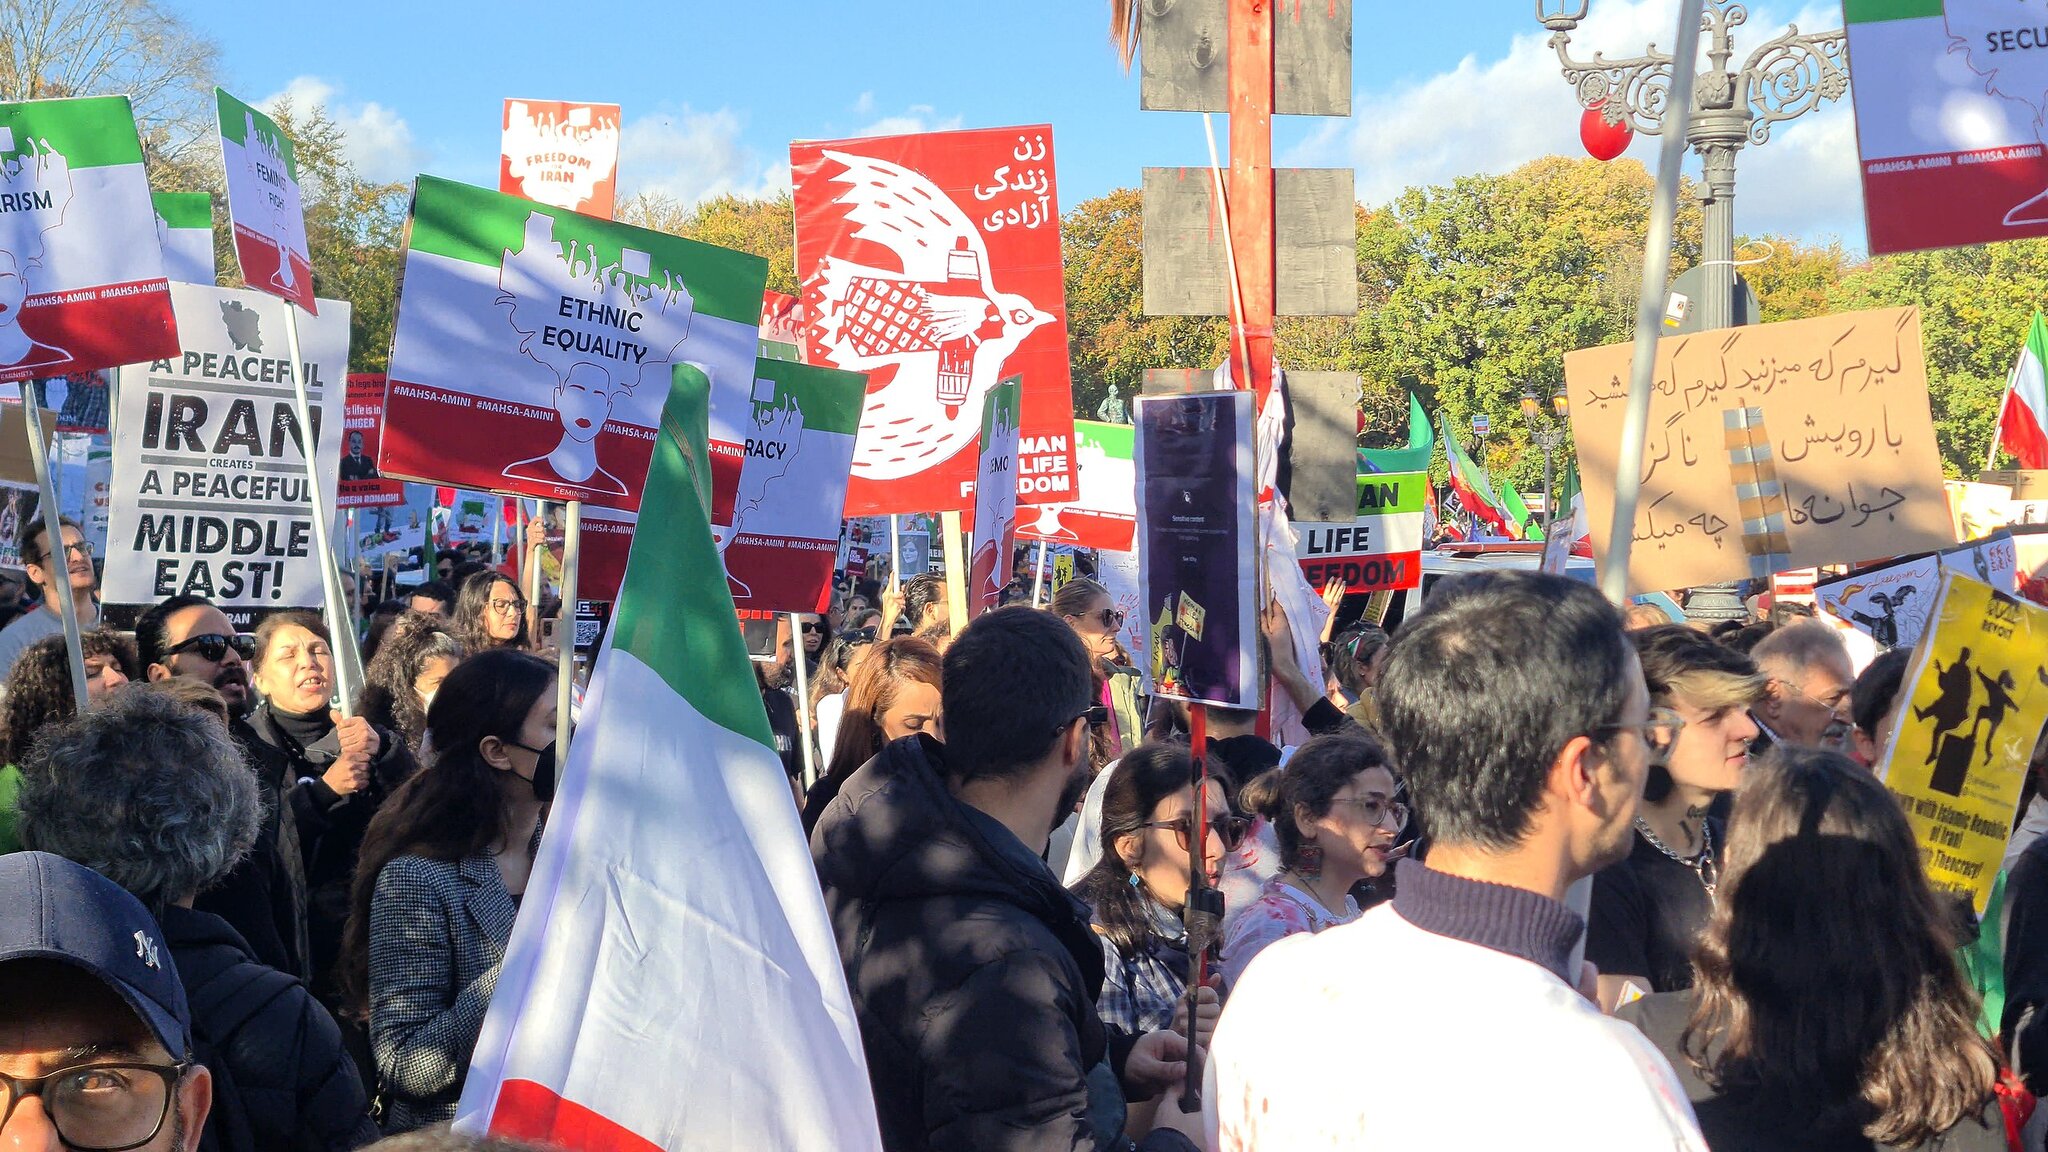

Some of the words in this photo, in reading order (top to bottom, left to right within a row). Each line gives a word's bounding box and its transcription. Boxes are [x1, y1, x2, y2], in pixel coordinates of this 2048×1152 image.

[526, 152, 591, 170] FREEDOM
[1013, 134, 1046, 162] زن
[1867, 157, 1952, 174] #MAHSA-AMINI
[1957, 147, 2042, 166] #MAHSA-AMINI
[540, 170, 575, 184] IRAN
[973, 165, 1049, 201] زندگی
[982, 195, 1050, 232] آزادی
[25, 291, 96, 308] #MAHSA-AMINI
[101, 281, 168, 299] #MAHSA-AMINI
[558, 296, 643, 333] ETHNIC
[542, 325, 648, 365] EQUALITY
[1808, 325, 1856, 381] که
[1839, 306, 1916, 393] گیرم
[149, 356, 173, 374] A
[183, 351, 323, 388] PEACEFUL
[1657, 338, 1690, 396] که
[1683, 331, 1742, 412] گیرم
[142, 391, 323, 458] IRAN
[393, 384, 471, 408] #MAHSA-AMINI
[476, 400, 554, 422] #MAHSA-AMINI
[603, 422, 657, 442] #MAHSA-AM
[707, 443, 745, 458] A-AMINI
[1017, 435, 1067, 455] MAN
[209, 458, 254, 470] CREATES
[1019, 456, 1068, 475] LIFE
[139, 470, 163, 495] A
[172, 472, 313, 503] PEACEFUL
[960, 475, 1070, 498] FDOM
[132, 513, 311, 557] MIDDLE
[580, 522, 634, 536] MAHSA-AMINI
[734, 535, 785, 548] #MAHSA-AMINI
[787, 540, 837, 552] #MAHSA-AMINI
[1307, 527, 1369, 554] LIFE
[153, 559, 284, 600] EAST!
[1308, 561, 1405, 588] EEDOM
